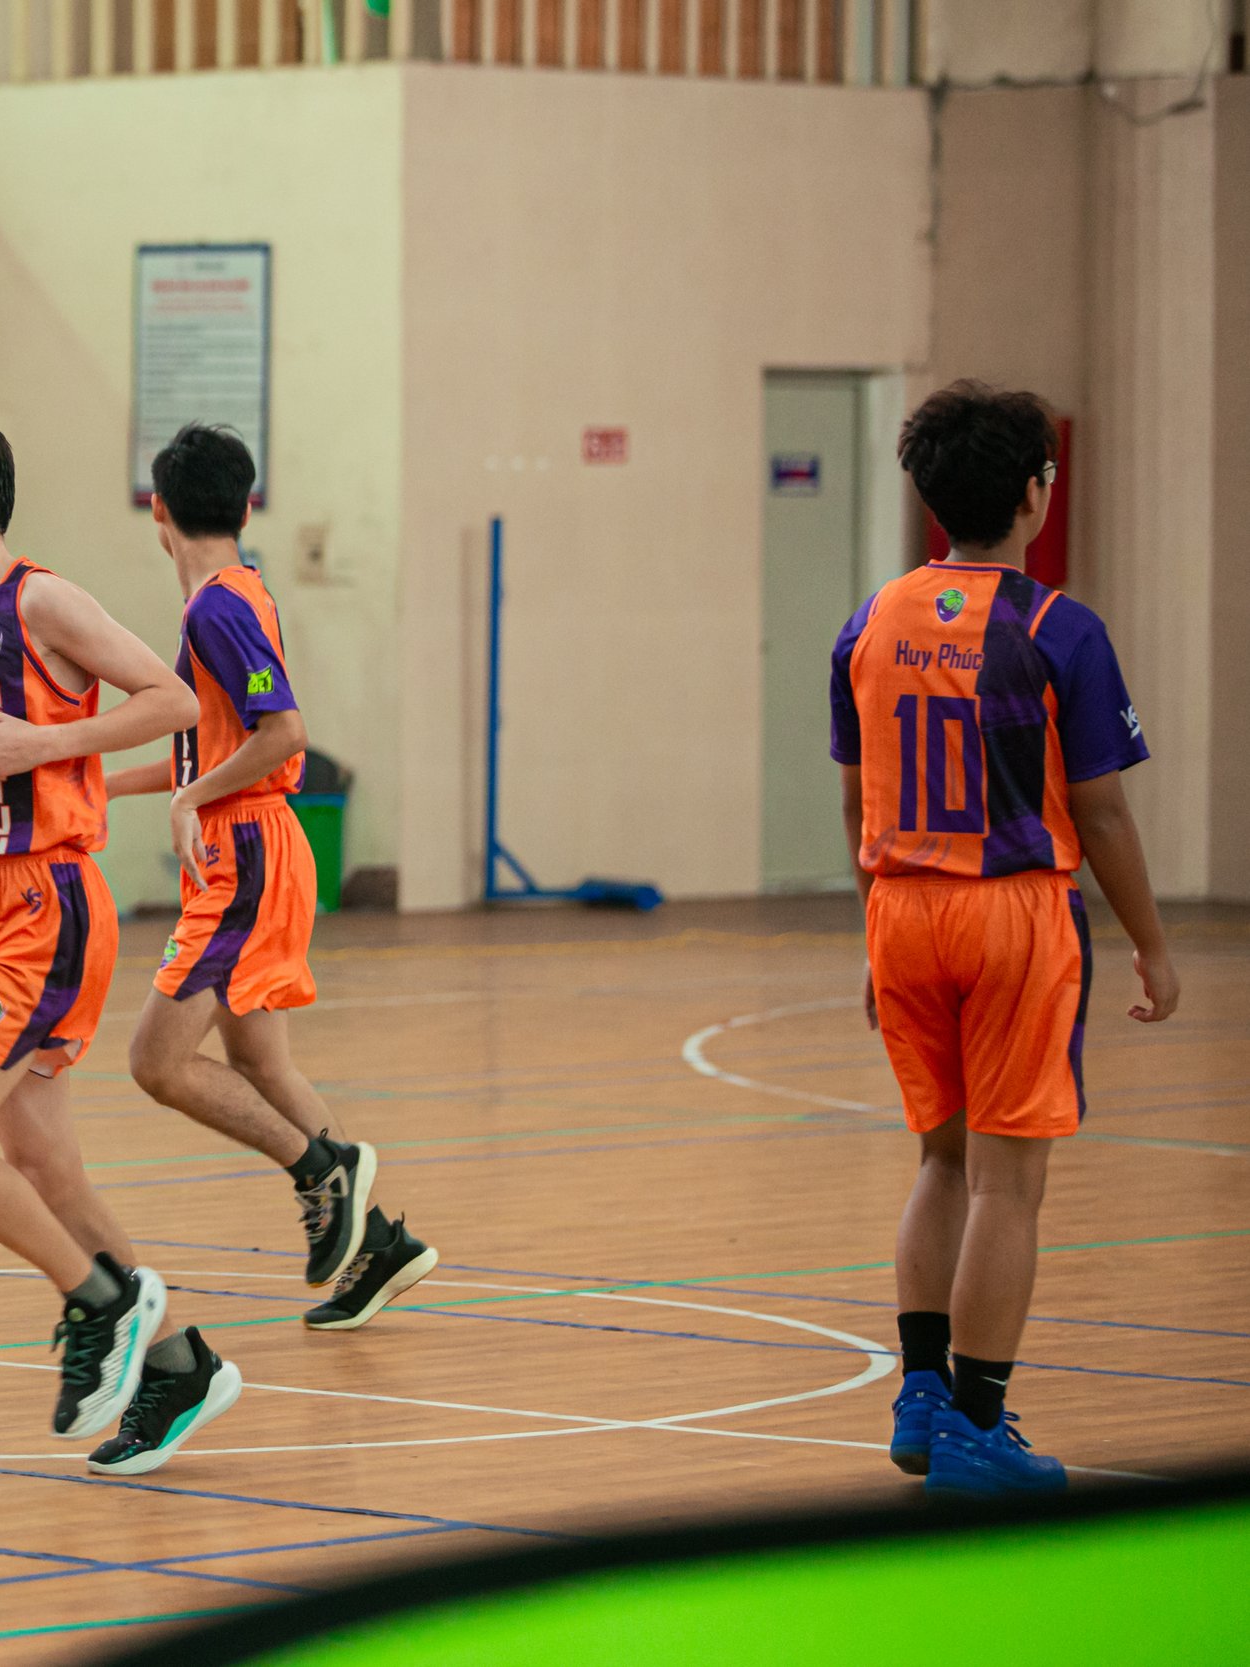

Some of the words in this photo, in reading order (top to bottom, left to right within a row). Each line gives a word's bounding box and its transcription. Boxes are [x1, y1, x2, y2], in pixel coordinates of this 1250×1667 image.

[895, 640, 933, 672] Huy
[937, 643, 985, 671] Phúc
[893, 694, 986, 834] 10
